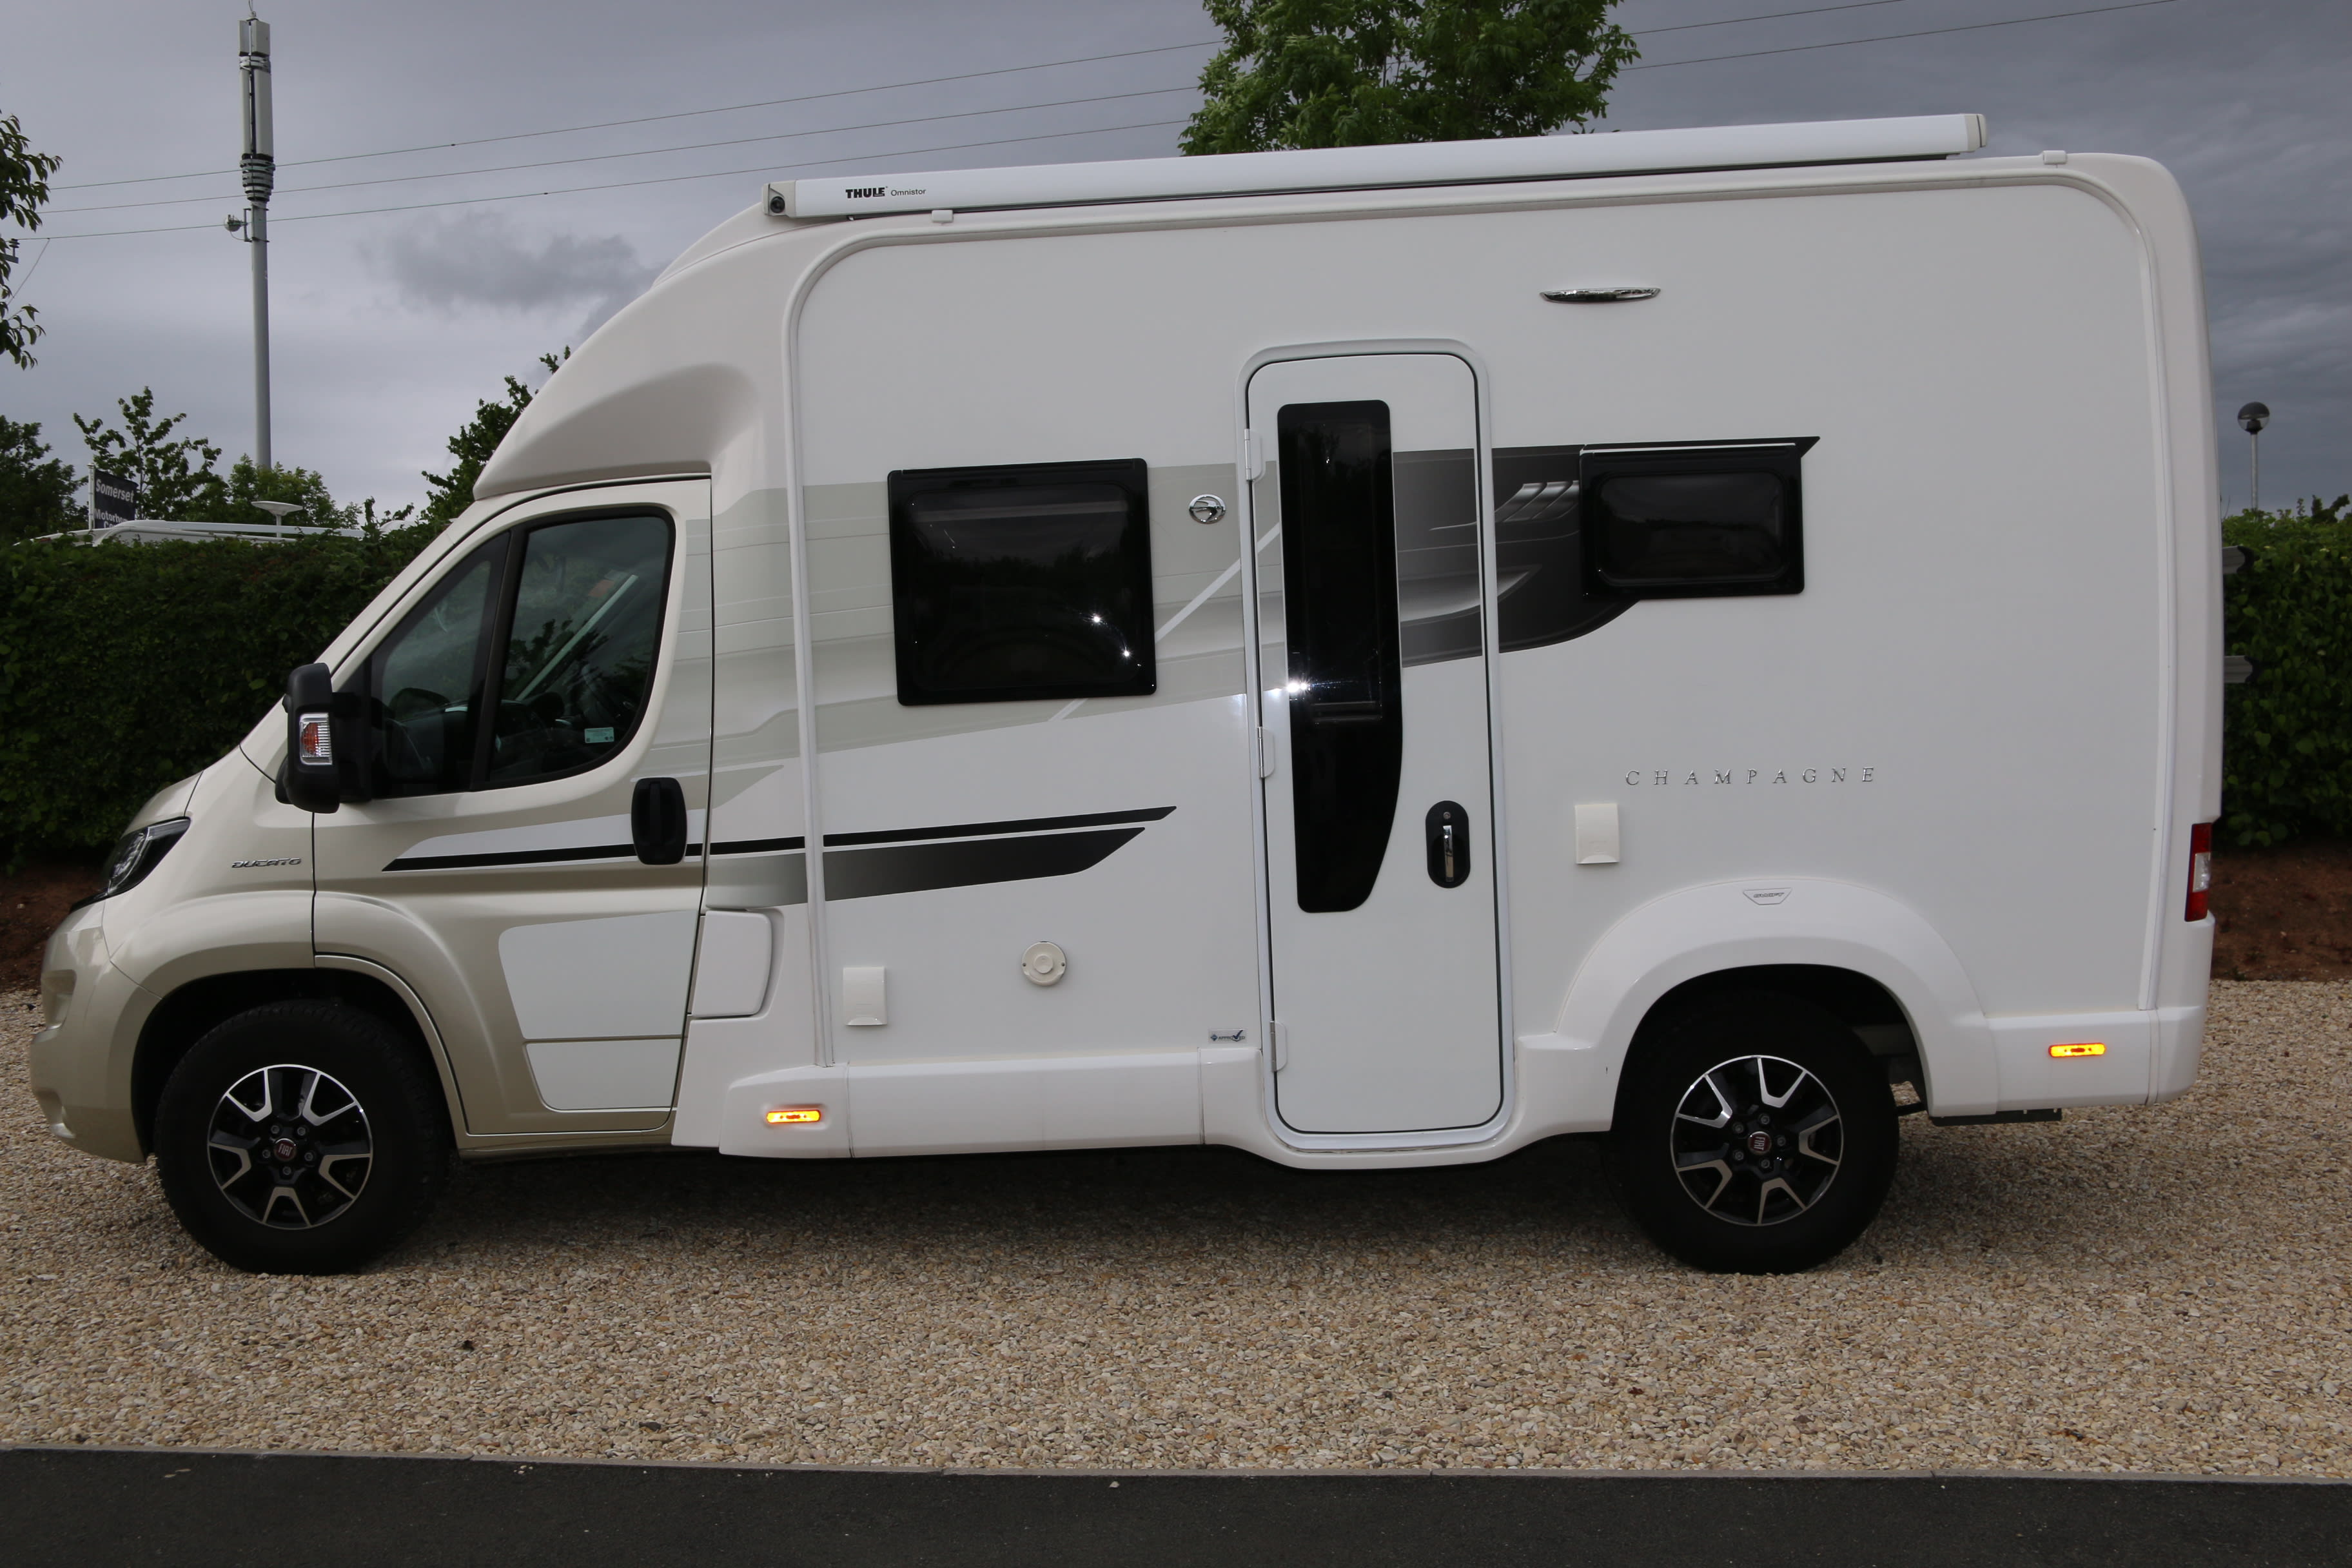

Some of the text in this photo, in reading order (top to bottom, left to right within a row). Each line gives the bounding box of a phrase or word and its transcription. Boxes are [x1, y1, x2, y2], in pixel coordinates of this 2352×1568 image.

[845, 187, 926, 199] THULE Omnistor
[95, 478, 135, 503] Somerset
[1625, 767, 1874, 786] CHAMPAGNE
[231, 858, 302, 868] DUCATO
[278, 1143, 293, 1157] FIAT
[1753, 1136, 1765, 1151] FIAT
